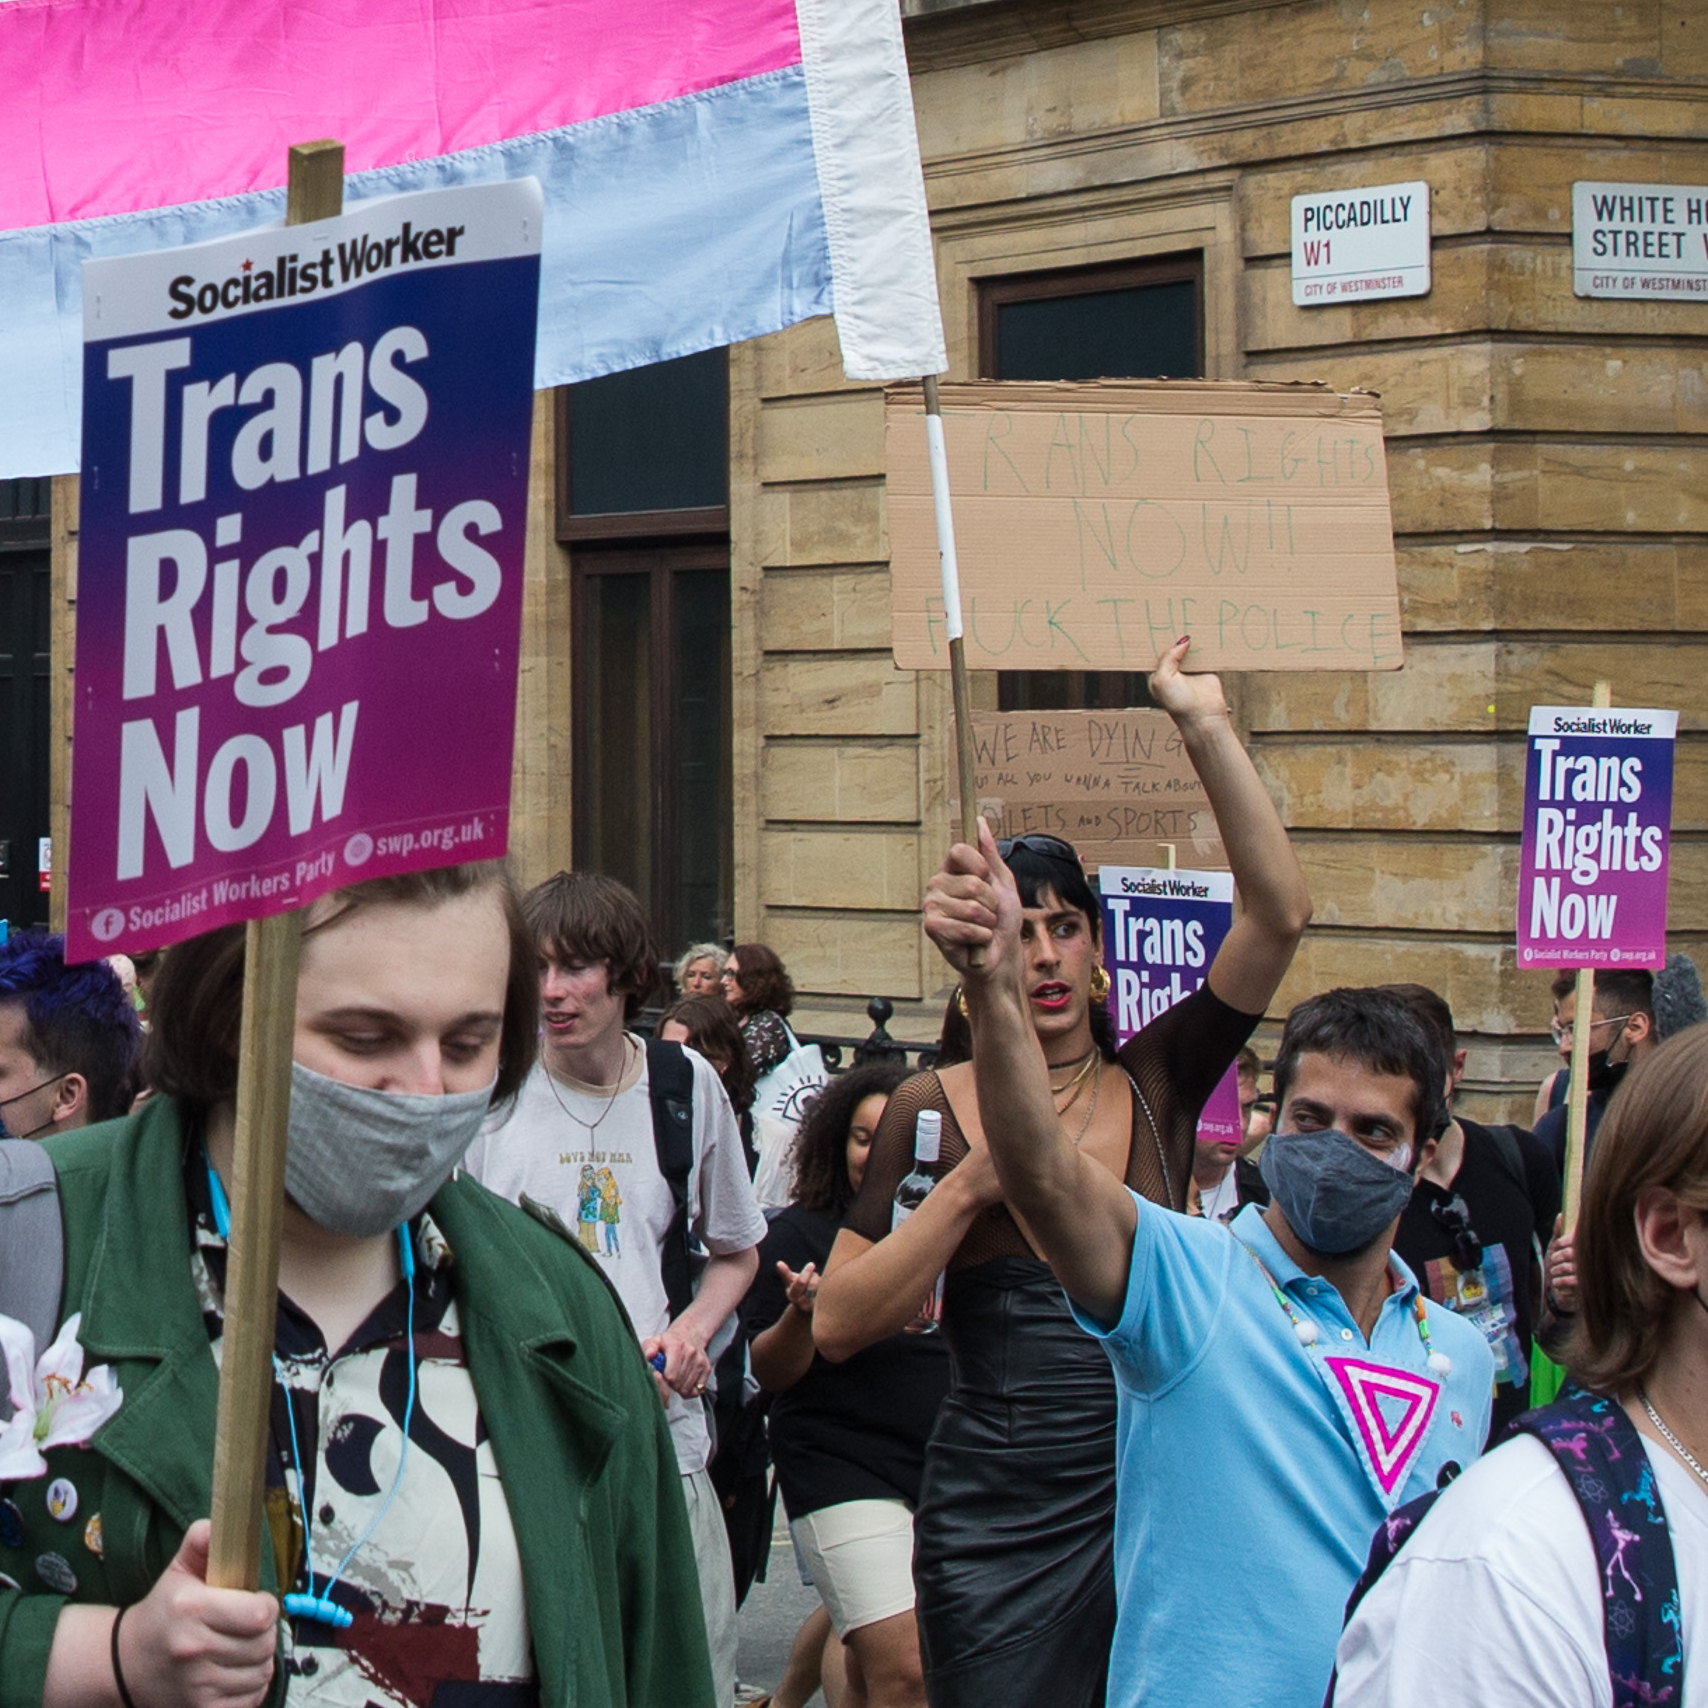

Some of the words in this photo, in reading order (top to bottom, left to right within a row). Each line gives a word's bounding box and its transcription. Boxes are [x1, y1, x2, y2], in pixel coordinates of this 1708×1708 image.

[1303, 195, 1412, 233] PICCADILLY
[1592, 194, 1675, 224] WHITE
[1687, 198, 1708, 225] H
[168, 245, 335, 322] Socialist
[336, 220, 465, 285] Worker
[1303, 239, 1331, 267] W1
[1592, 229, 1687, 259] STREET
[1304, 283, 1324, 297] CITY
[1326, 282, 1338, 295] OF
[1340, 275, 1404, 293] WESTMINSTER
[1592, 275, 1618, 289] CITY
[1622, 276, 1637, 290] OF
[106, 325, 429, 516] Trans
[1193, 418, 1377, 487] RIGHTS
[122, 472, 503, 708] Rights
[924, 596, 1090, 663] FUCK
[1096, 597, 1201, 660] THE
[1218, 598, 1403, 666] POLICE
[971, 722, 1020, 766] WE
[1029, 721, 1066, 754] ARE
[1087, 719, 1184, 763] DYING
[1553, 716, 1608, 733] Socialist
[1609, 718, 1653, 736] Worker
[116, 700, 359, 882] Now
[1027, 771, 1052, 787] YOU
[1534, 738, 1643, 803] Trans
[1106, 806, 1198, 843] SPORTS
[1534, 807, 1663, 885] Rights
[128, 892, 209, 933] Socialist
[213, 872, 290, 907] Workers
[295, 850, 336, 887] Party
[376, 816, 484, 854] swp.org.uk
[1121, 876, 1167, 896] Socialist
[1168, 879, 1210, 898] Worker
[1107, 898, 1206, 968] Trans
[1530, 876, 1617, 940] Now
